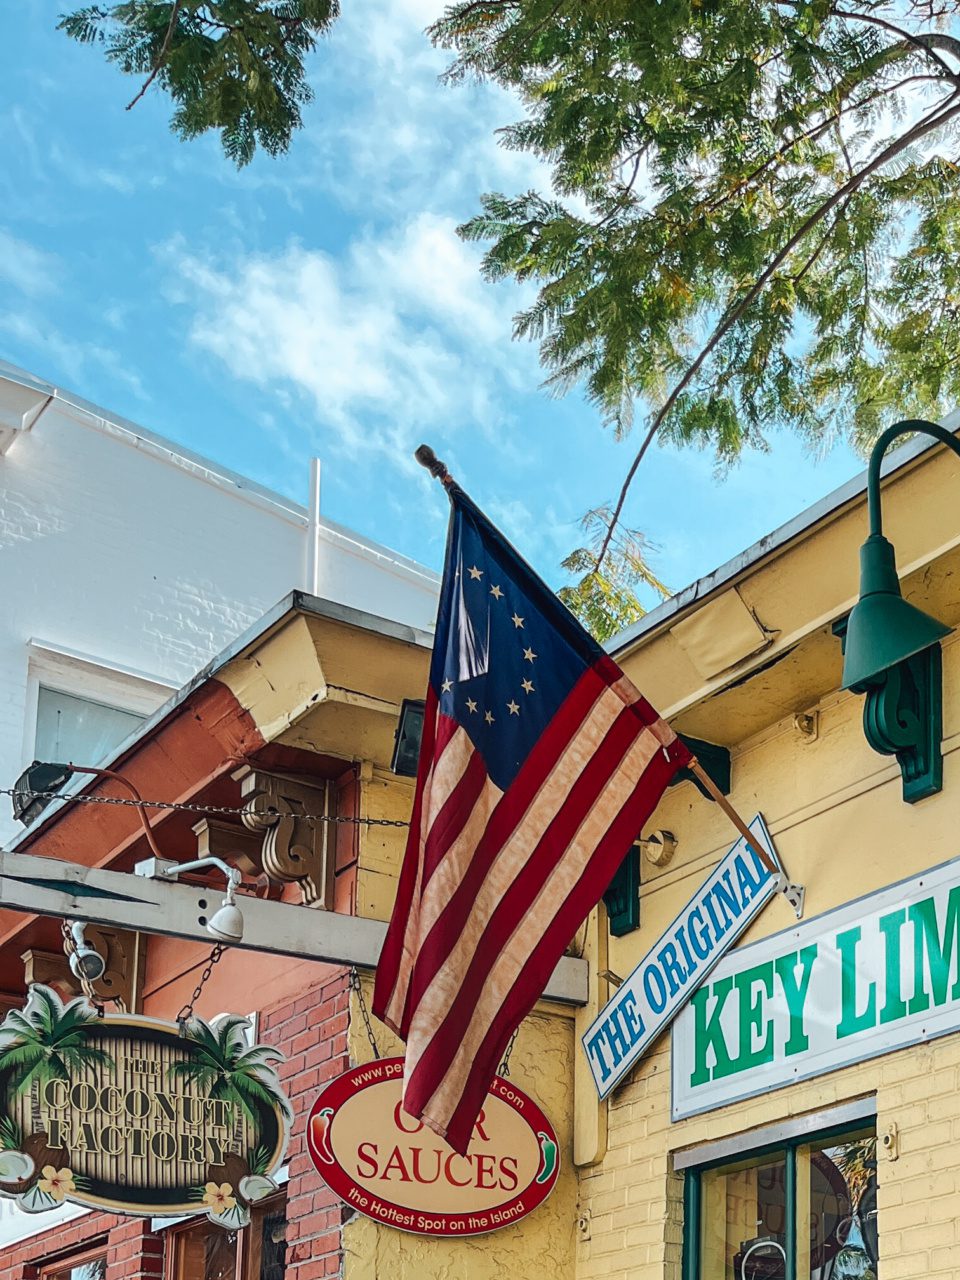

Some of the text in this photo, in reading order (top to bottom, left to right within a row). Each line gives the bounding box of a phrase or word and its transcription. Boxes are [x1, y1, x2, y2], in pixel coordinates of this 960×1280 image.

[586, 843, 773, 1084] THE ORIGINAL
[690, 942, 818, 1088] KEY
[123, 1056, 161, 1076] THE
[44, 1078, 231, 1129] COCONUT
[46, 1118, 230, 1166] FACTORY
[356, 1142, 518, 1191] SAUCES
[348, 1187, 525, 1231] the Hottest Spot on the Island
